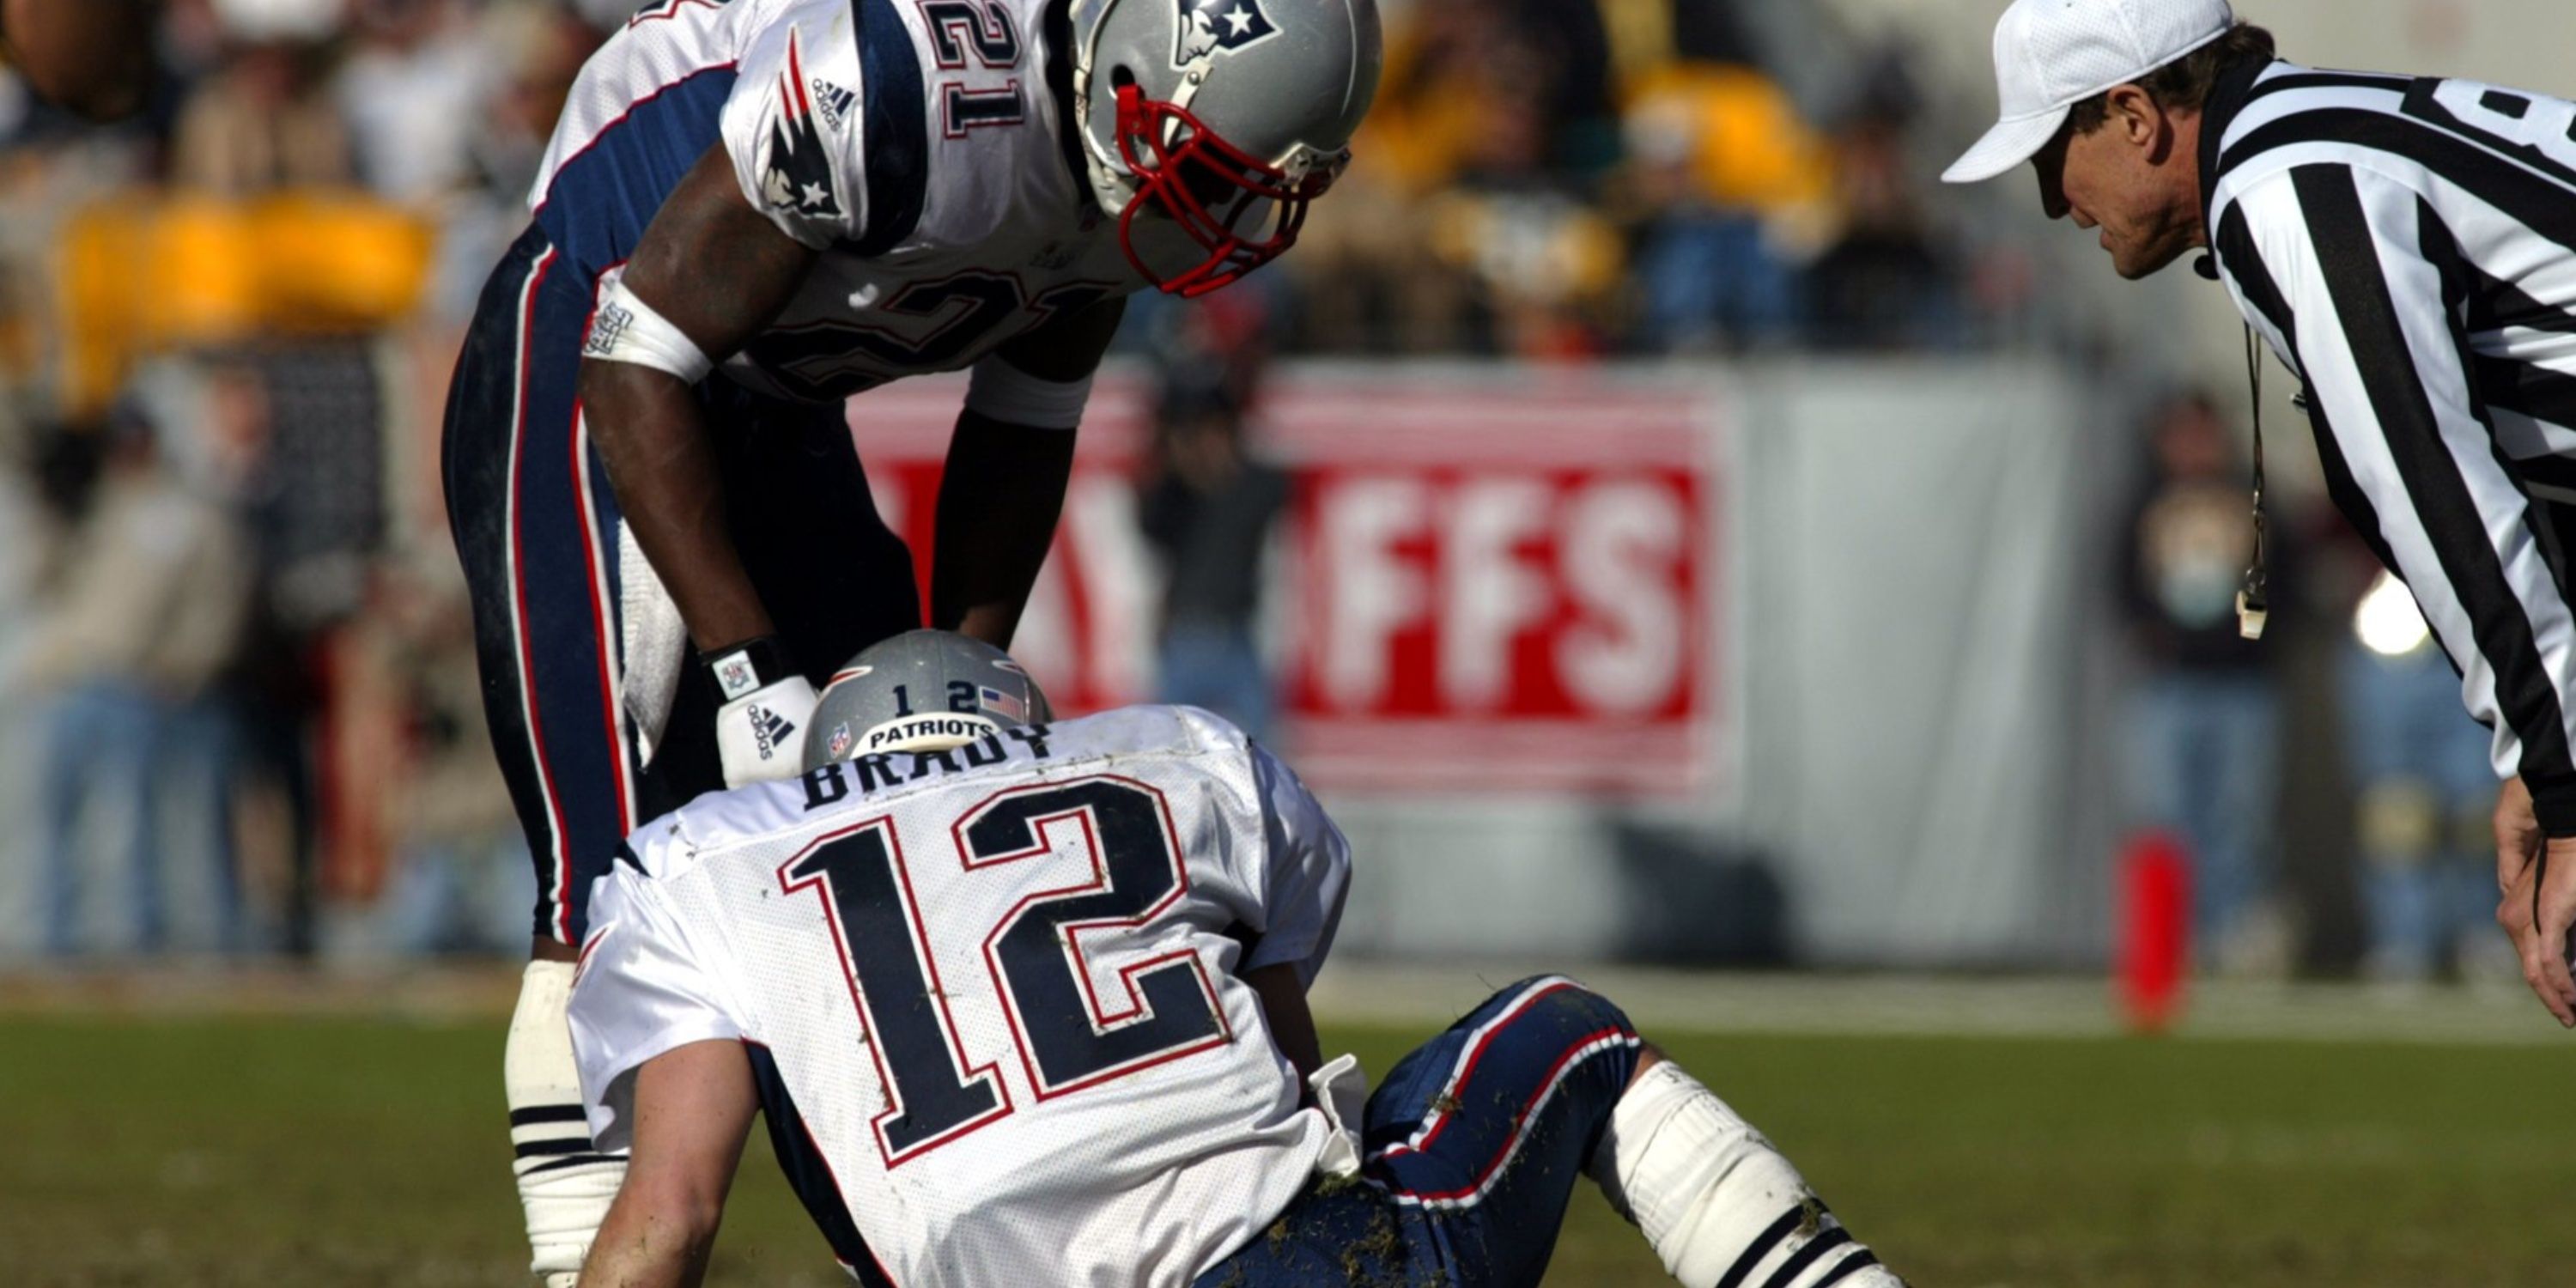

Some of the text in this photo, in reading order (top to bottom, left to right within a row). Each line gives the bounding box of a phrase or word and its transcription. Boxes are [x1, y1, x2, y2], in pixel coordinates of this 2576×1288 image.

[812, 78, 841, 132] adidas
[914, 0, 1024, 139] 21
[748, 704, 773, 761] adidas
[804, 724, 1051, 811] BRADY
[870, 720, 993, 749] PATRIOTS
[777, 774, 1232, 1170] 12
